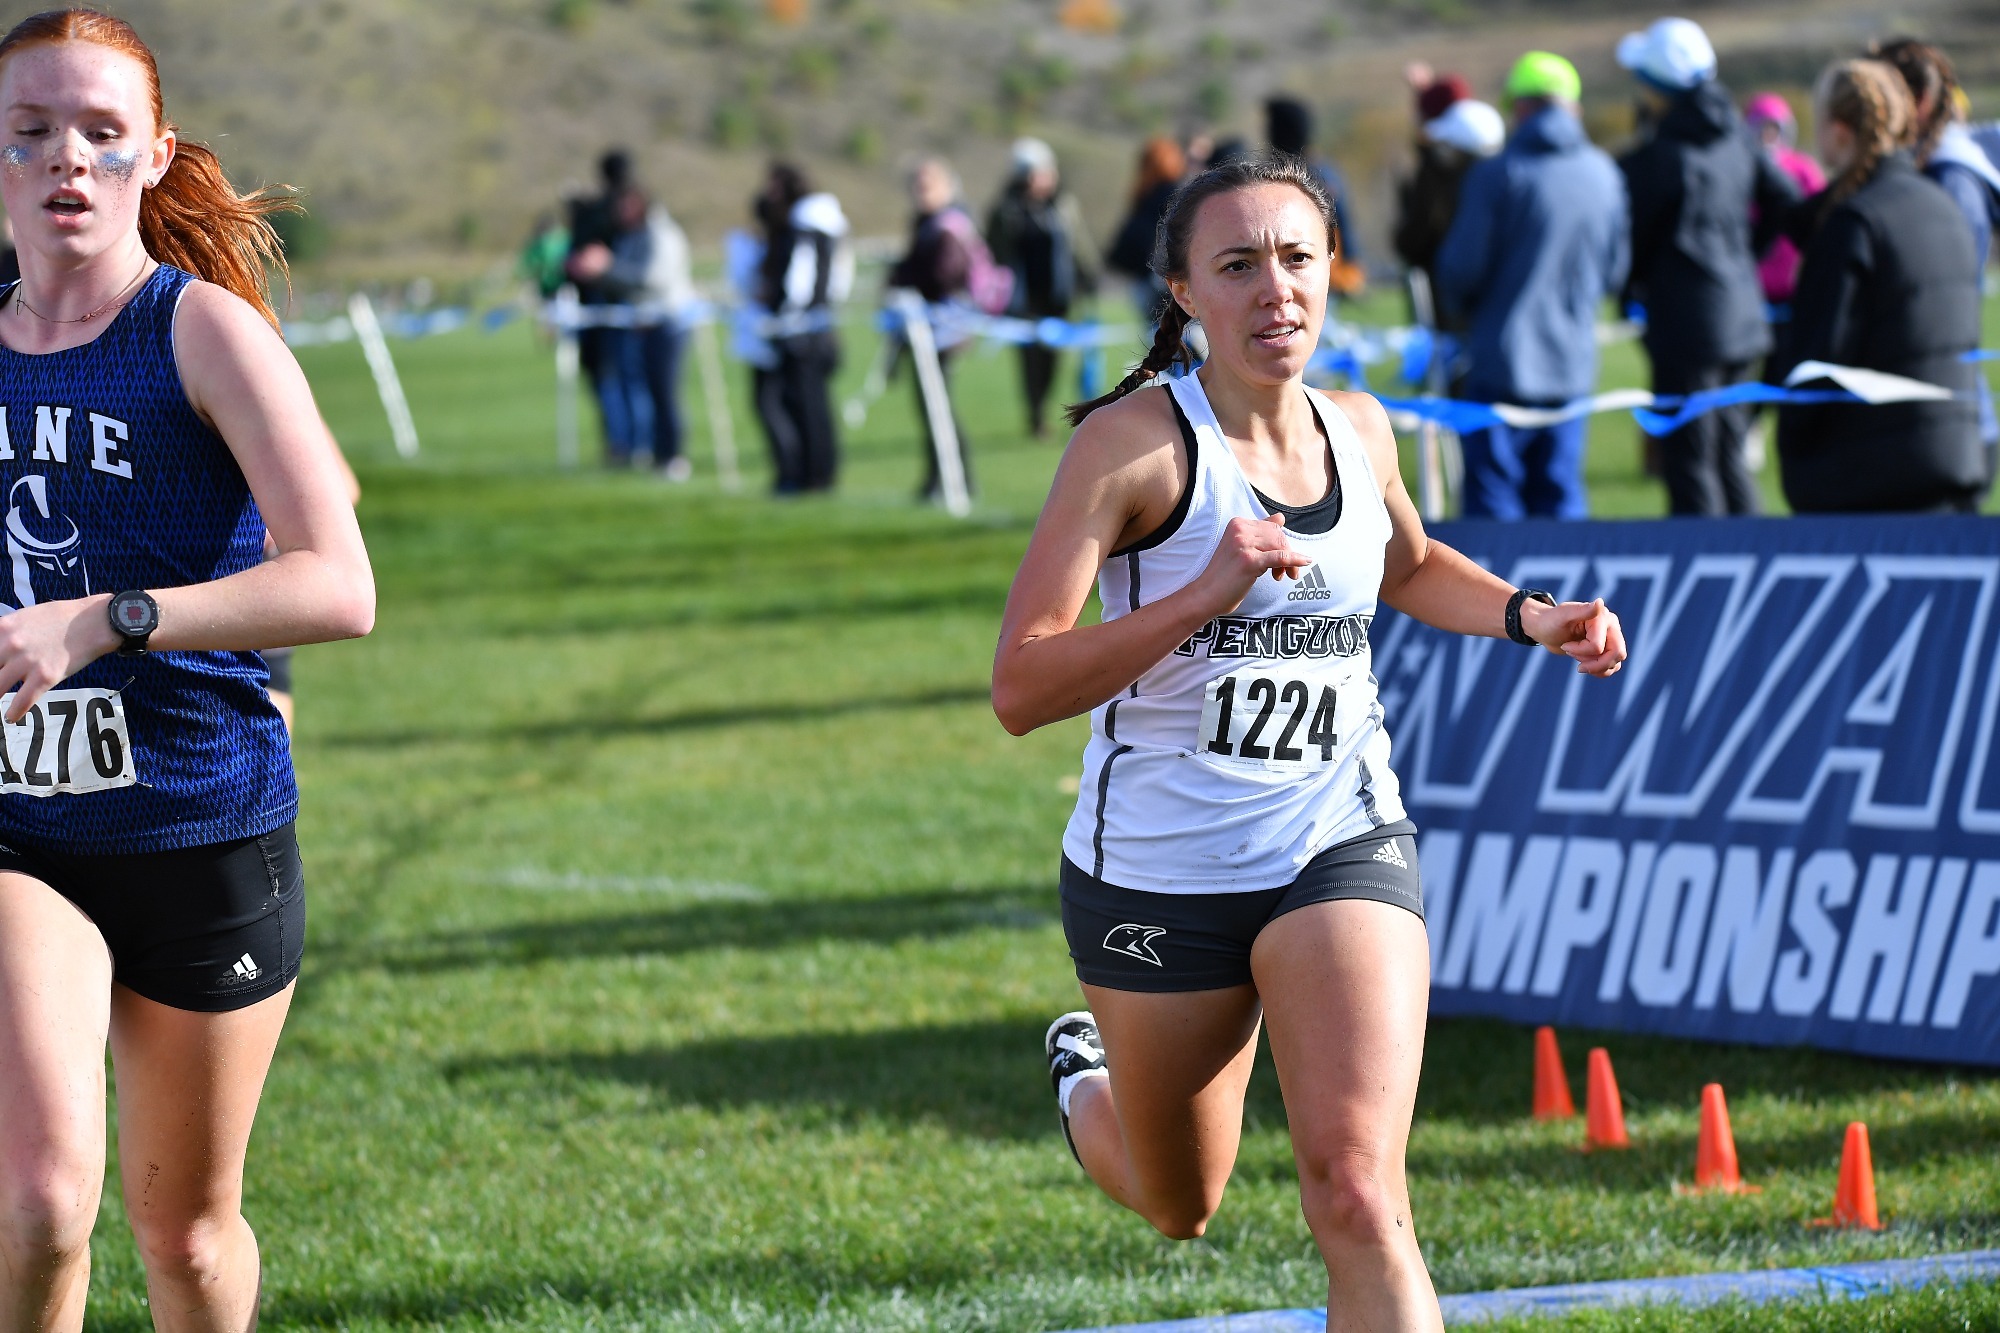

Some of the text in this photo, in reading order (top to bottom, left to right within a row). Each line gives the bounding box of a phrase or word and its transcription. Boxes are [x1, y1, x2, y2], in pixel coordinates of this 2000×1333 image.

[1287, 587, 1331, 602] adidas
[1372, 554, 2000, 833] NWA
[1208, 677, 1337, 761] 1224
[217, 969, 263, 985] adidas
